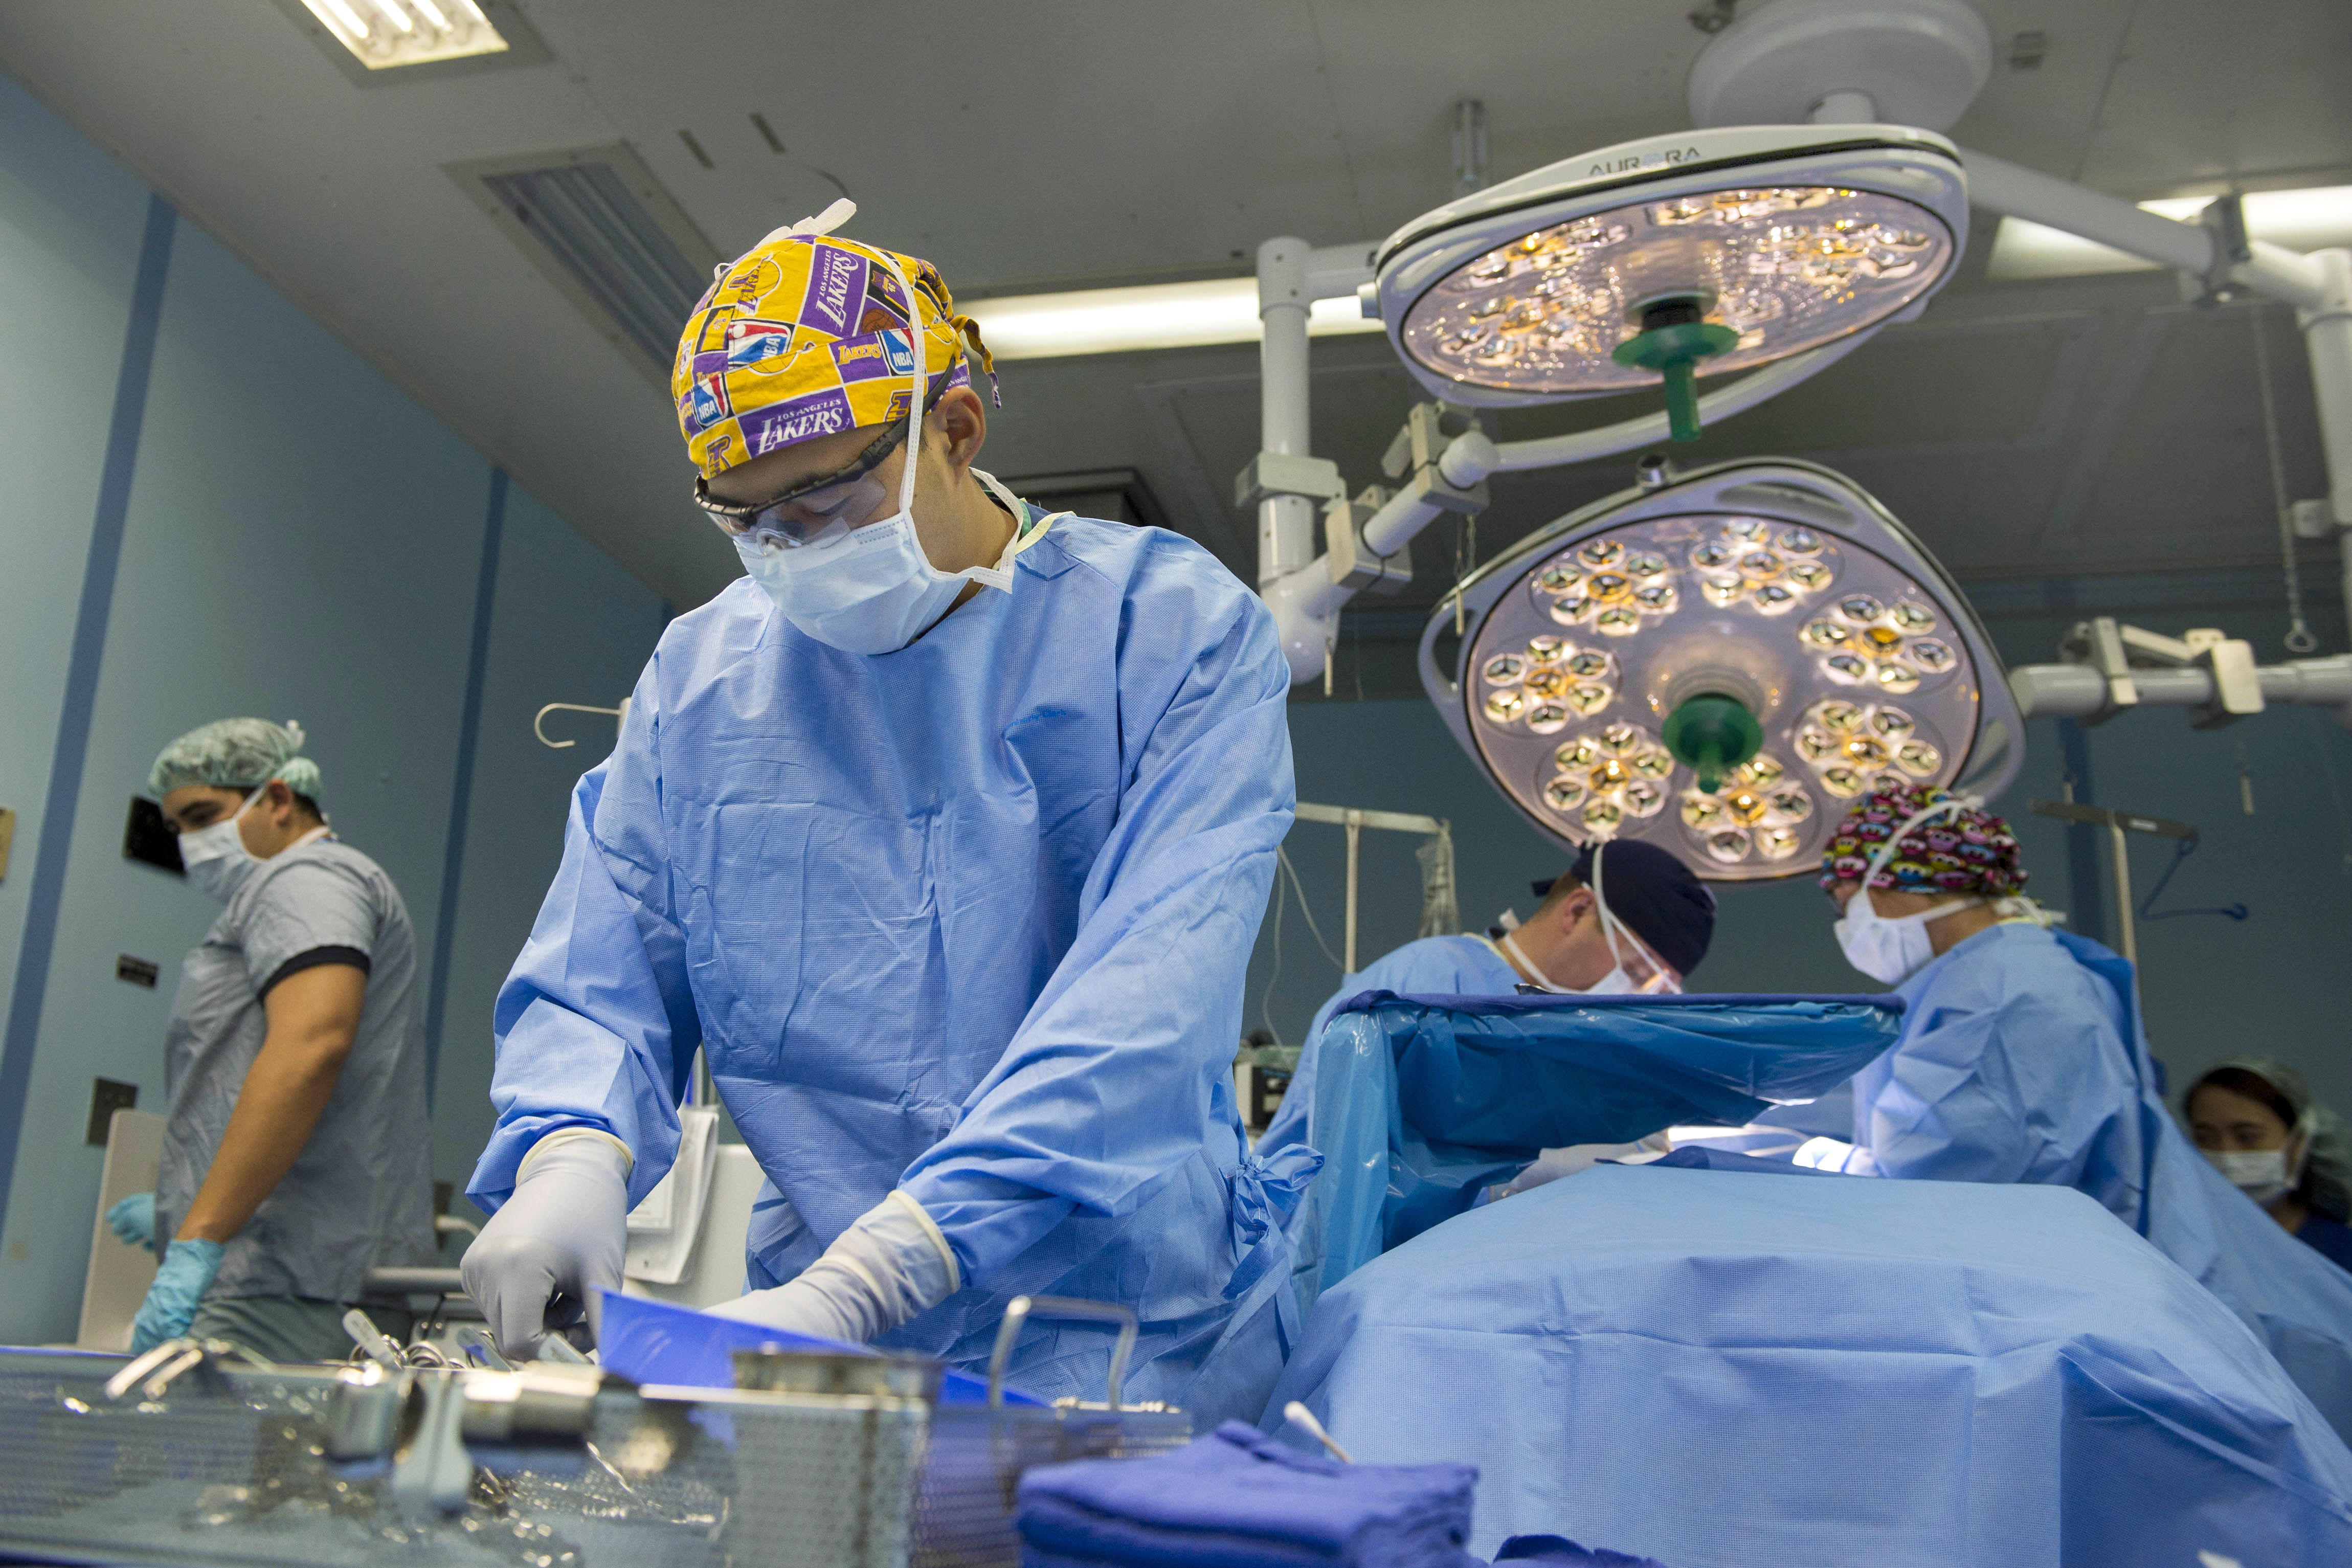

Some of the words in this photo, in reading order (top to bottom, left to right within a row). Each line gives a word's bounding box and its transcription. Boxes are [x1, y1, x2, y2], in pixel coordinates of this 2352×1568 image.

[819, 281, 827, 297] LOS
[823, 250, 832, 281] ANGELES
[815, 252, 859, 332] LAKERS
[760, 338, 781, 360] NBA
[837, 343, 882, 366] LAKERS
[892, 352, 913, 367] NBA
[698, 400, 716, 420] NBA
[777, 411, 795, 422] LOS
[796, 398, 841, 416] ANGELES
[755, 407, 849, 455] LAKERS
